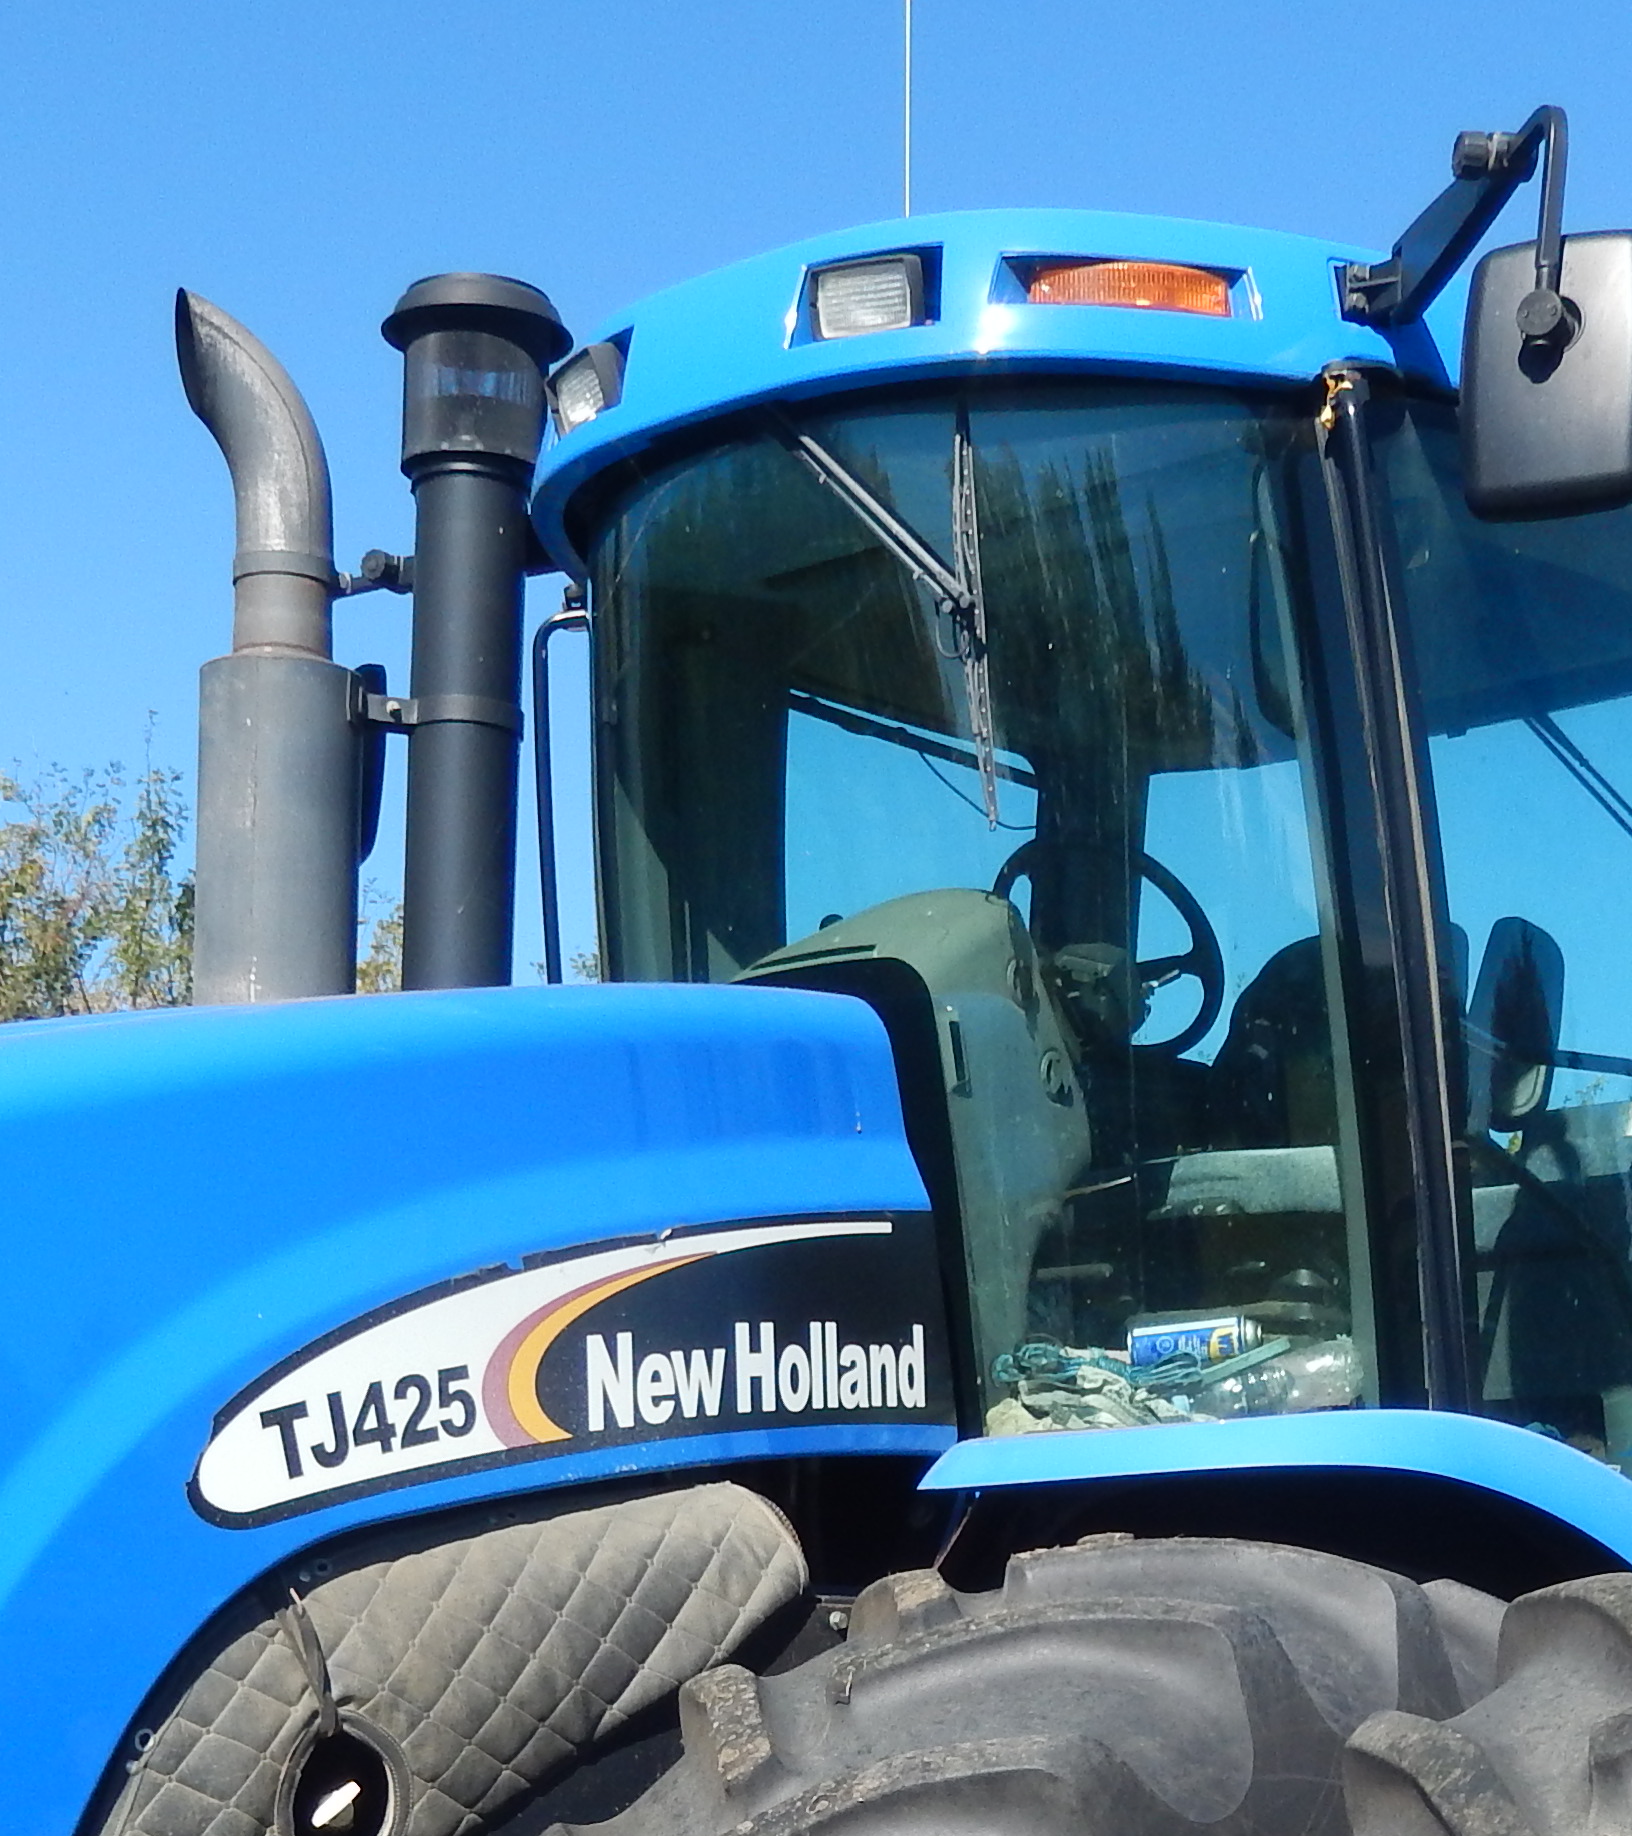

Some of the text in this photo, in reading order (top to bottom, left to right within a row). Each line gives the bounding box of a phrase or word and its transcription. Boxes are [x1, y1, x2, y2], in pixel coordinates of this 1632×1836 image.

[260, 1364, 480, 1480] TJ425
[585, 1320, 926, 1432] New Holland
